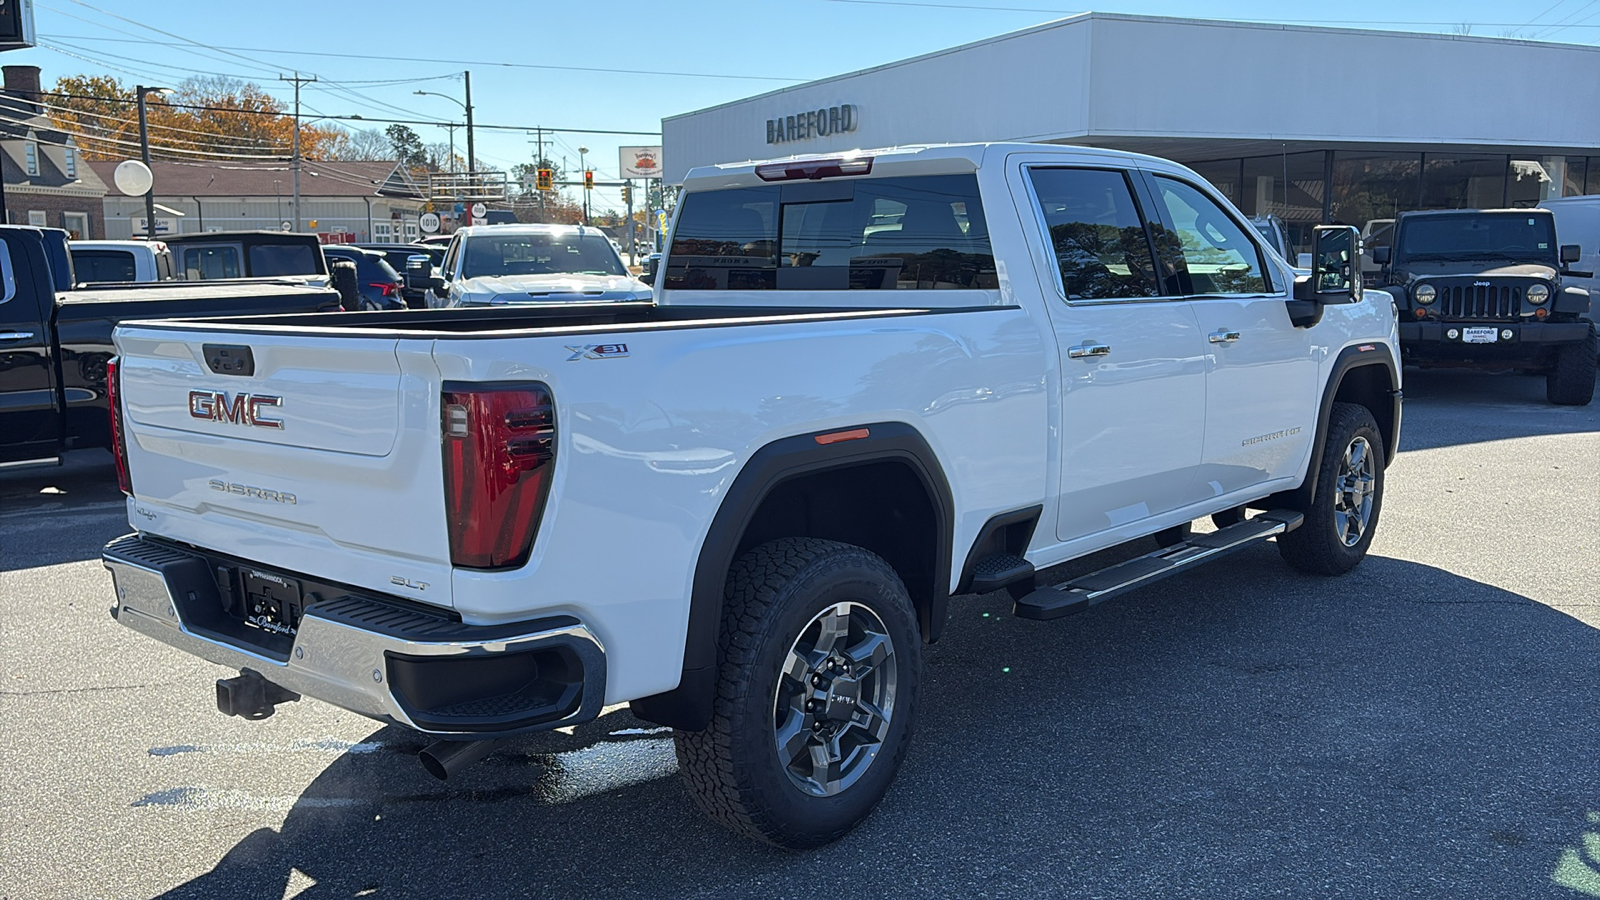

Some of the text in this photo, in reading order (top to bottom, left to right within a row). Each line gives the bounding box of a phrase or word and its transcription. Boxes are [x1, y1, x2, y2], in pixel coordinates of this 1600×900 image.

[766, 104, 858, 144] BAREFORD
[188, 387, 285, 431] GMC
[1241, 430, 1284, 447] SIERRA
[208, 479, 297, 505] SIERRA
[390, 575, 431, 591] SLT
[256, 615, 291, 634] Bareford
